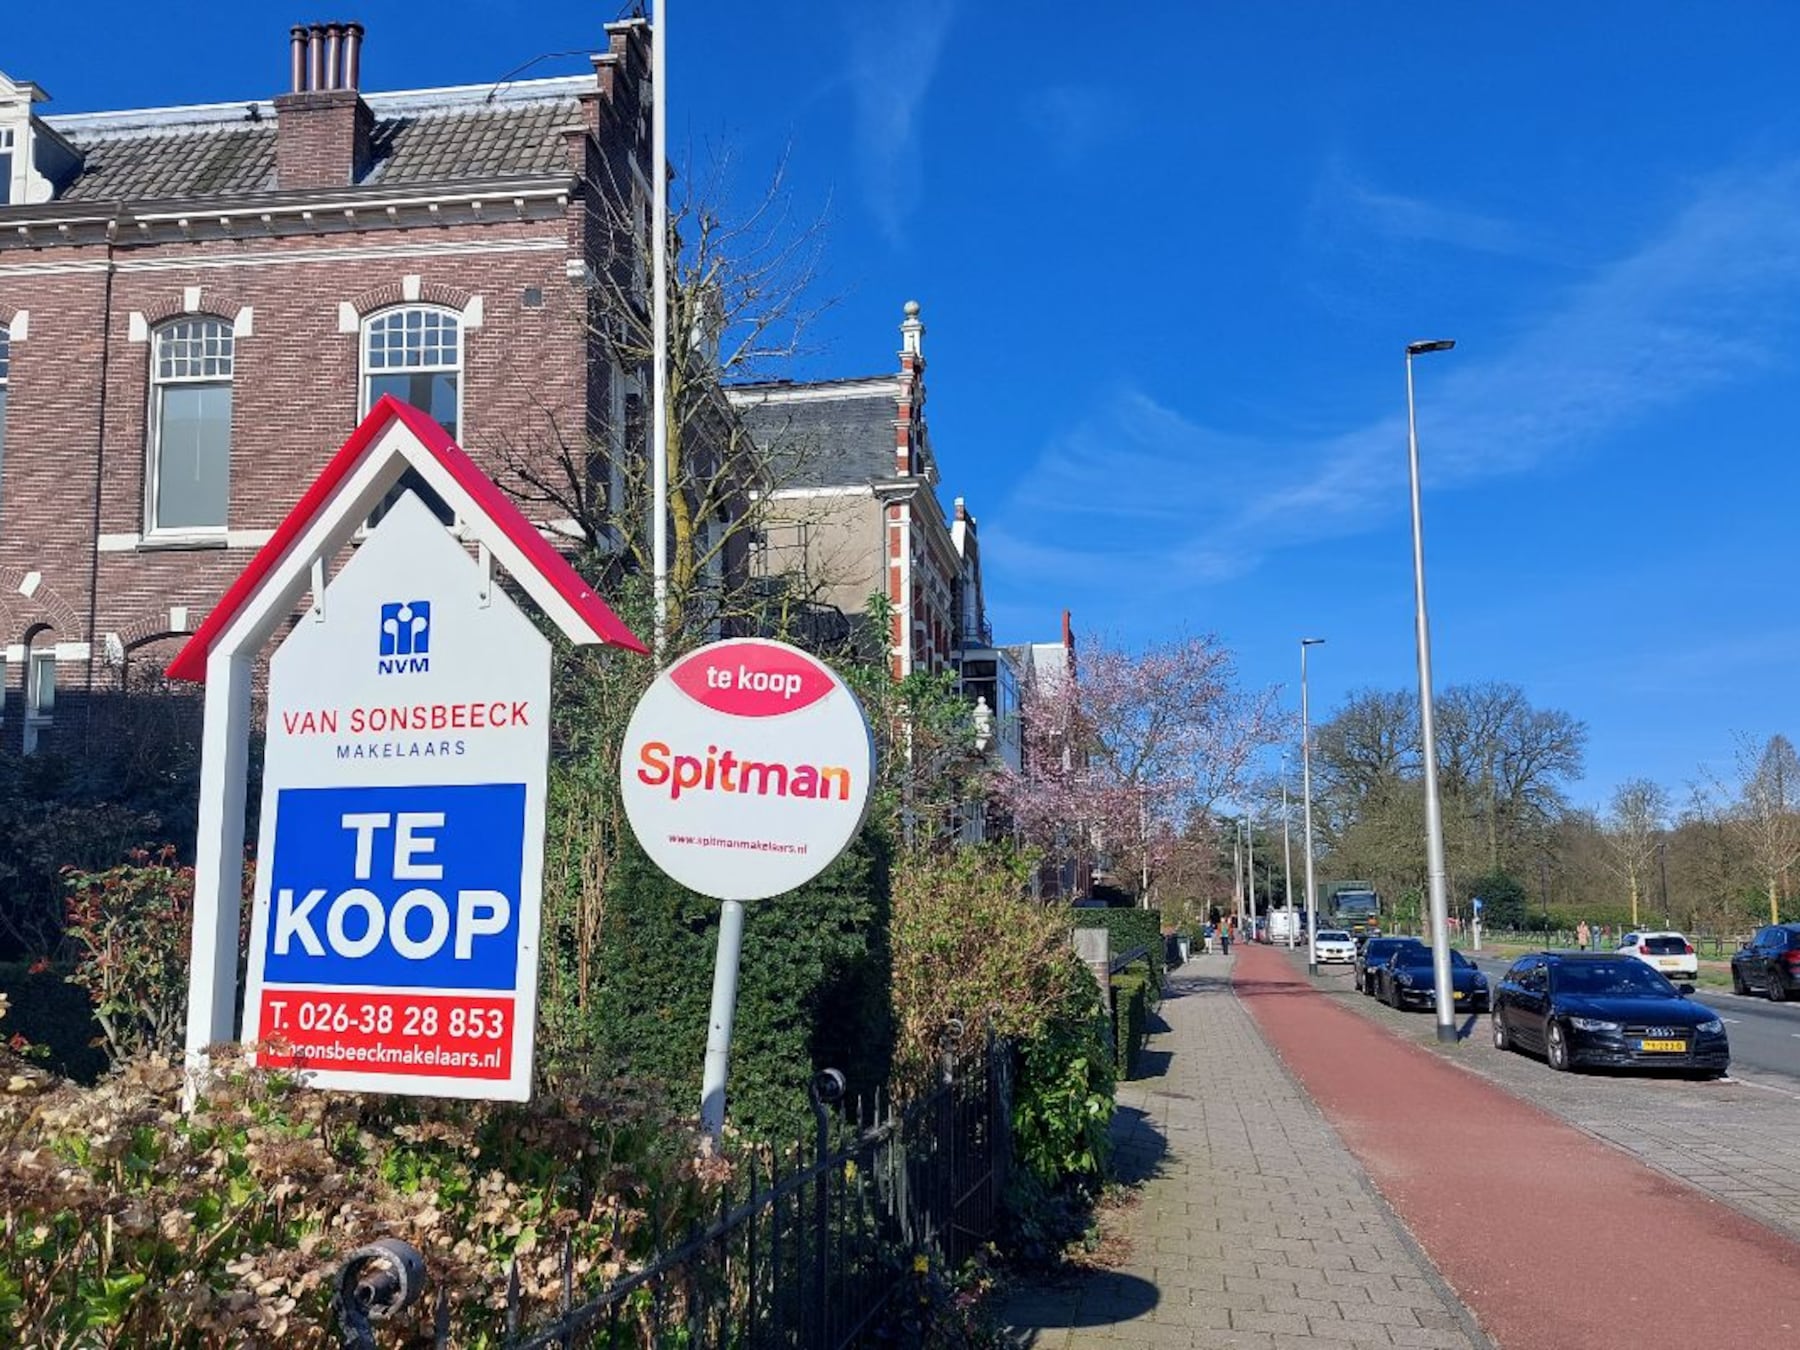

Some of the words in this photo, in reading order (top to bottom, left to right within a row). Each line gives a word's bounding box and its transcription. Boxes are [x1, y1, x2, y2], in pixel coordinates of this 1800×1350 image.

[378, 658, 429, 675] NVM
[707, 665, 732, 689] te
[738, 665, 802, 699] koop
[283, 710, 337, 735] VAN
[350, 701, 529, 733] SONSBEECK
[336, 740, 466, 759] MAKELAARS
[637, 741, 851, 800] Spitman
[341, 812, 446, 880] TE
[668, 834, 808, 855] www.spitmanmakelaars.nl
[274, 888, 511, 960] KOOP
[269, 1001, 289, 1029] T.
[299, 1003, 393, 1033] 026-38
[402, 1006, 439, 1036] 28
[448, 1008, 504, 1039] 853
